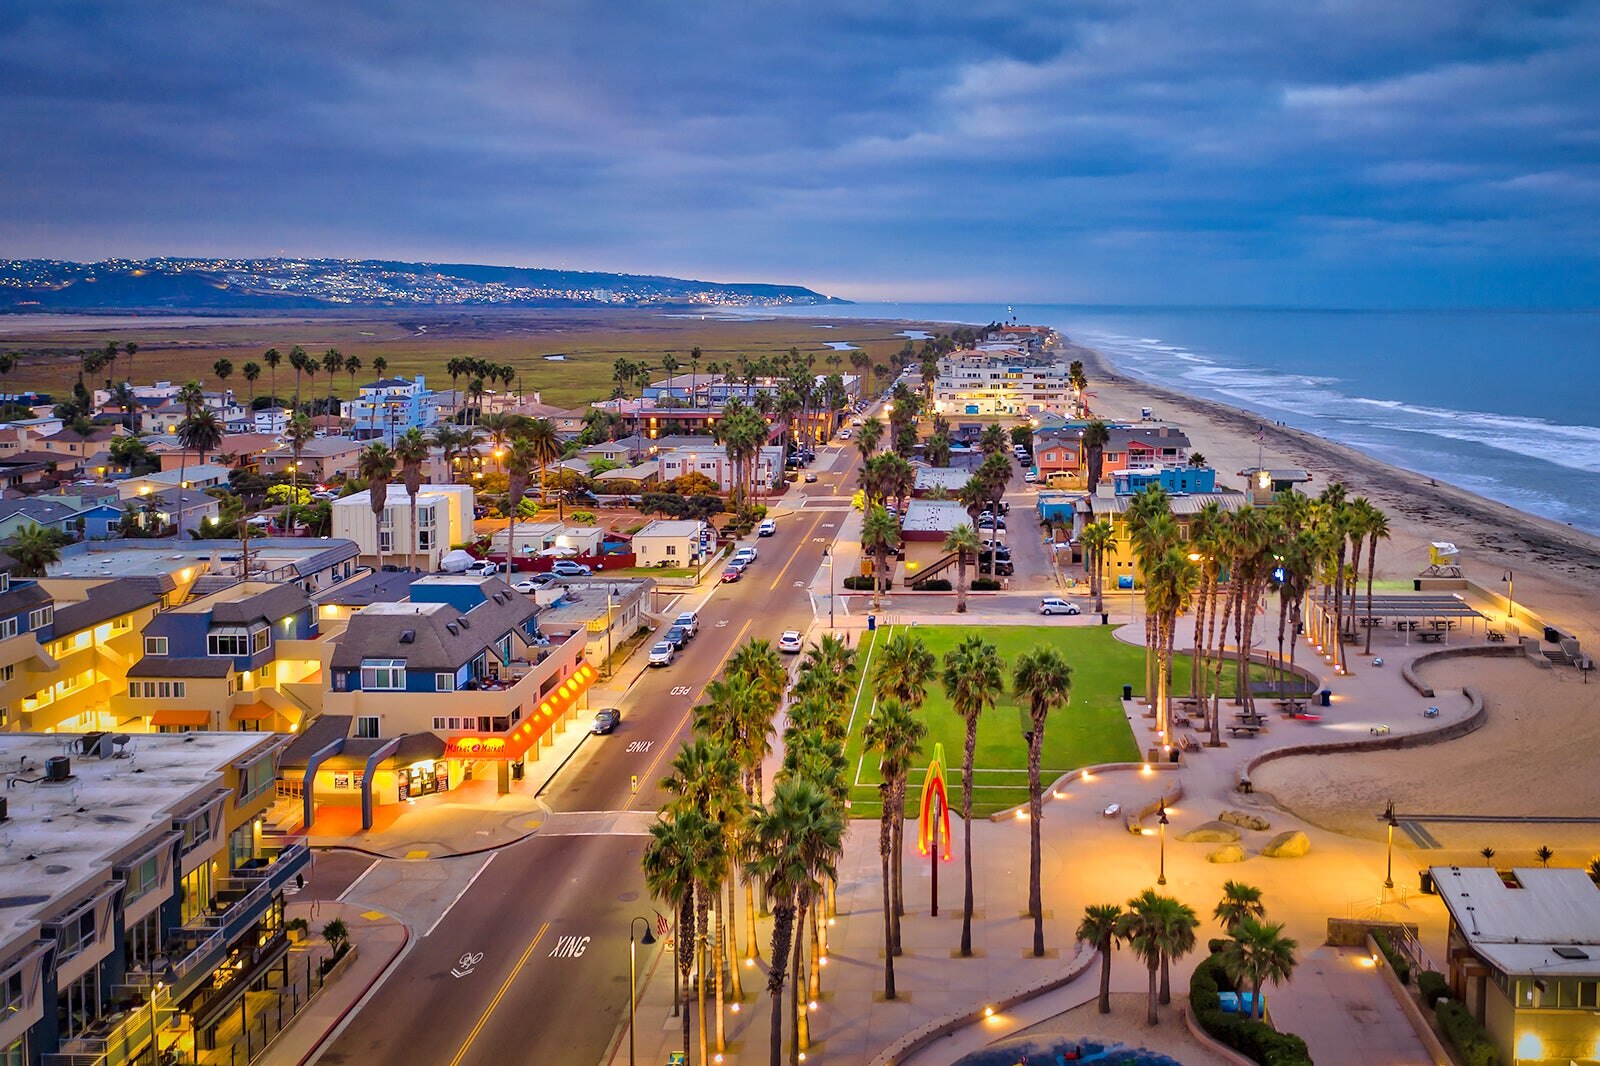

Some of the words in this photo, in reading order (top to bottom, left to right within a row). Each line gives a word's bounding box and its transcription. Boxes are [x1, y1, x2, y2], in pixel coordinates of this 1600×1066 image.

[670, 686, 692, 695] PED
[446, 743, 470, 752] Market
[481, 743, 504, 752] Market
[626, 741, 654, 753] XING
[548, 936, 591, 958] XING
